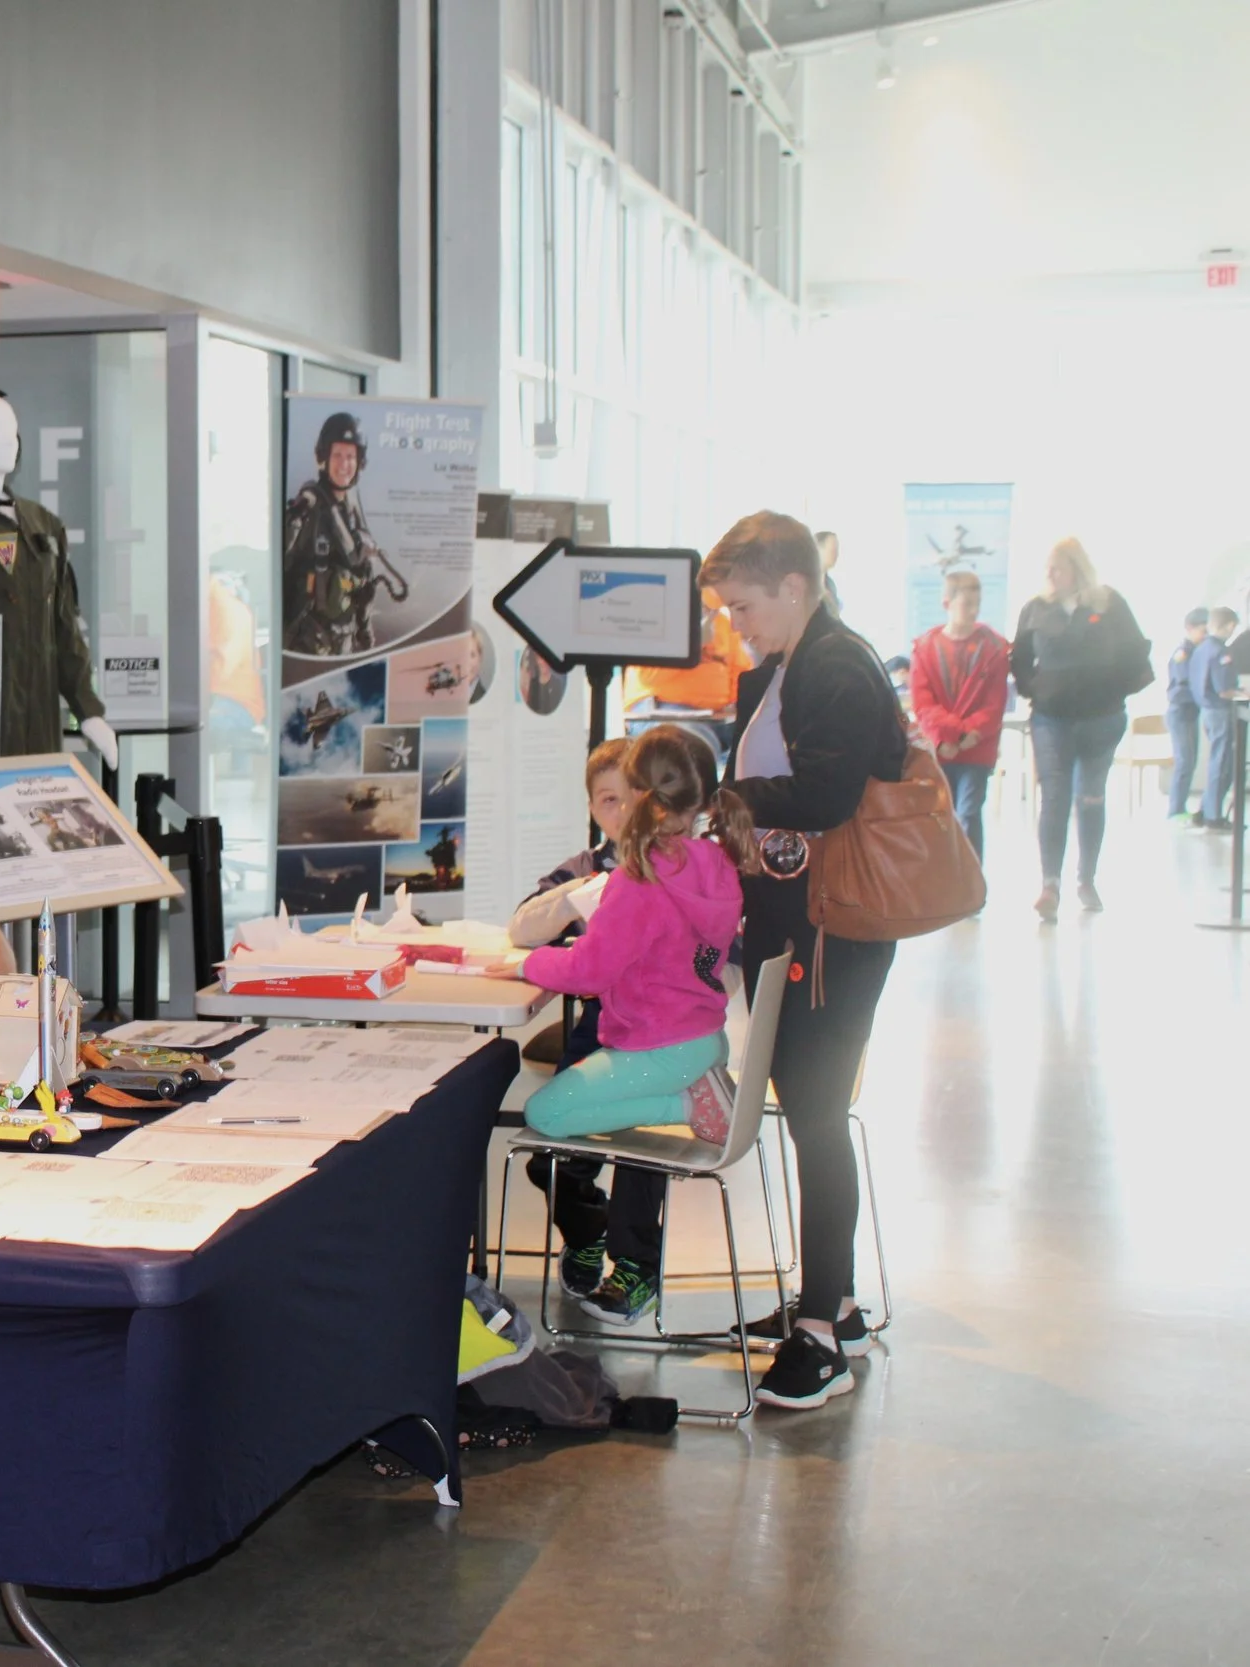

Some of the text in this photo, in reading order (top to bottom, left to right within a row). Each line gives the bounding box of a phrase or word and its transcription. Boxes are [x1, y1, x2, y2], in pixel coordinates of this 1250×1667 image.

[1207, 264, 1238, 288] EXIT
[385, 412, 471, 433] Flight Test
[379, 432, 477, 456] Photography
[110, 659, 155, 670] NOTICE
